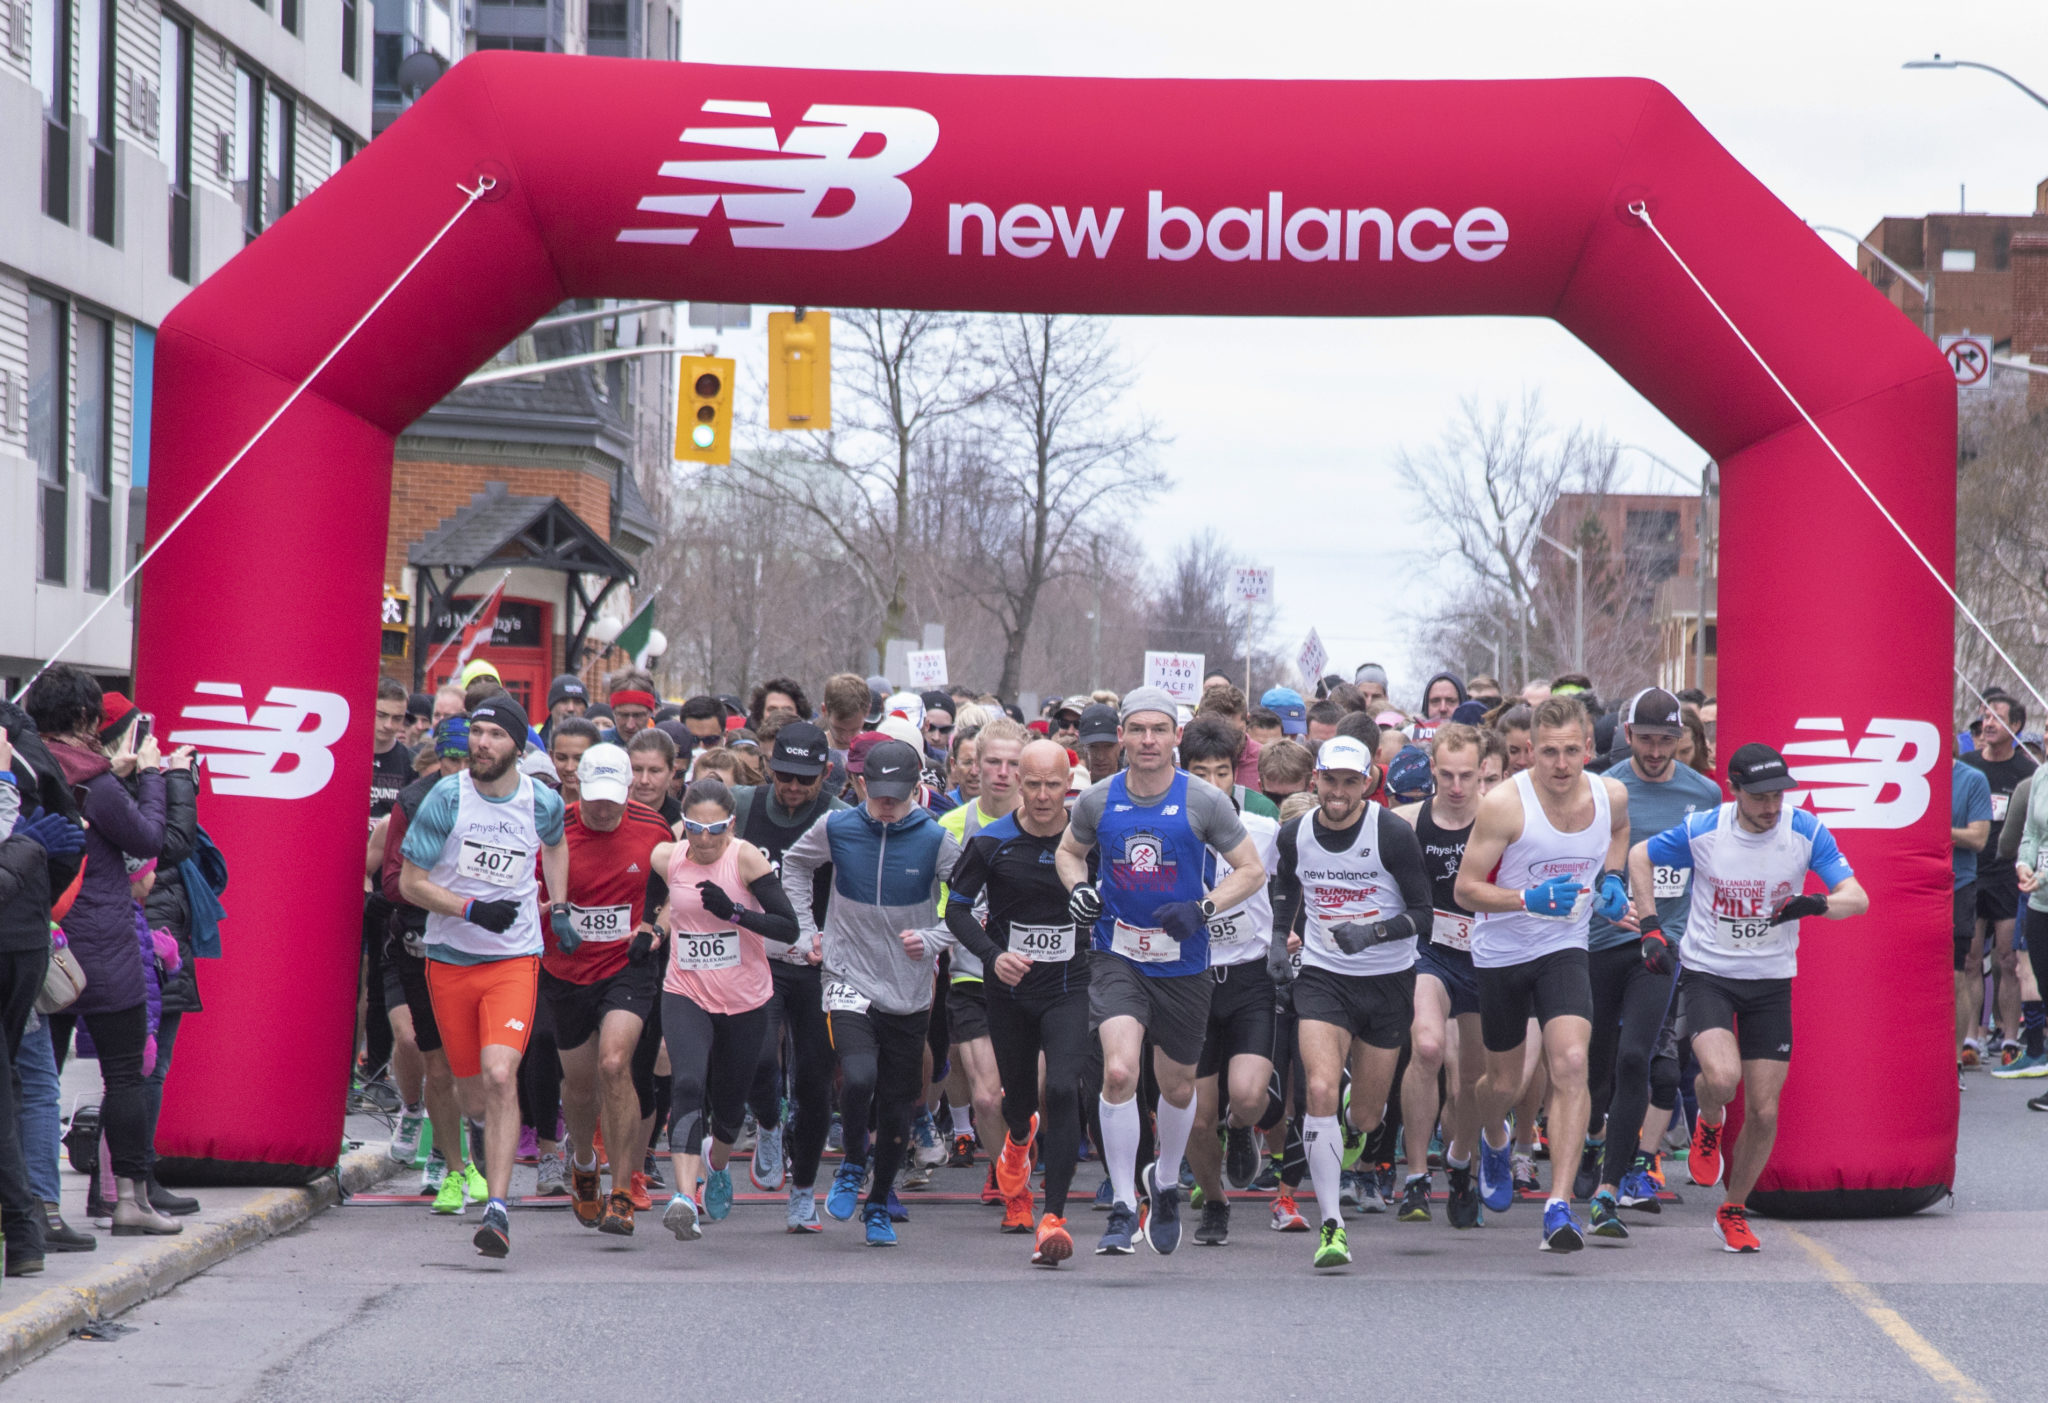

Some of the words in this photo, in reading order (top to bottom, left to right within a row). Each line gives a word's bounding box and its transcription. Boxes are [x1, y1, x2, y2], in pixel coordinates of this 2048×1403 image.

[947, 200, 1125, 260] new
[1146, 189, 1510, 264] balance
[1161, 667, 1192, 678] 1:40
[1155, 680, 1195, 691] PACER
[786, 746, 810, 757] OCRC
[1425, 843, 1465, 857] Physi-K
[474, 851, 514, 873] 407
[1304, 870, 1326, 880] new
[1327, 869, 1378, 881] balance
[1653, 868, 1681, 885] 36
[1321, 894, 1367, 904] CHOICE
[1712, 890, 1765, 918] MILE
[580, 913, 617, 930] 489
[1209, 921, 1237, 938] 95
[1457, 923, 1469, 938] 3
[1731, 923, 1770, 939] 562
[688, 939, 725, 957] 306
[1023, 933, 1062, 950] 408
[1139, 936, 1151, 951] 5
[1017, 946, 1045, 955] ANTHONY
[703, 955, 737, 963] ALEXANDER
[1291, 953, 1302, 968] 6
[827, 983, 857, 999] 442
